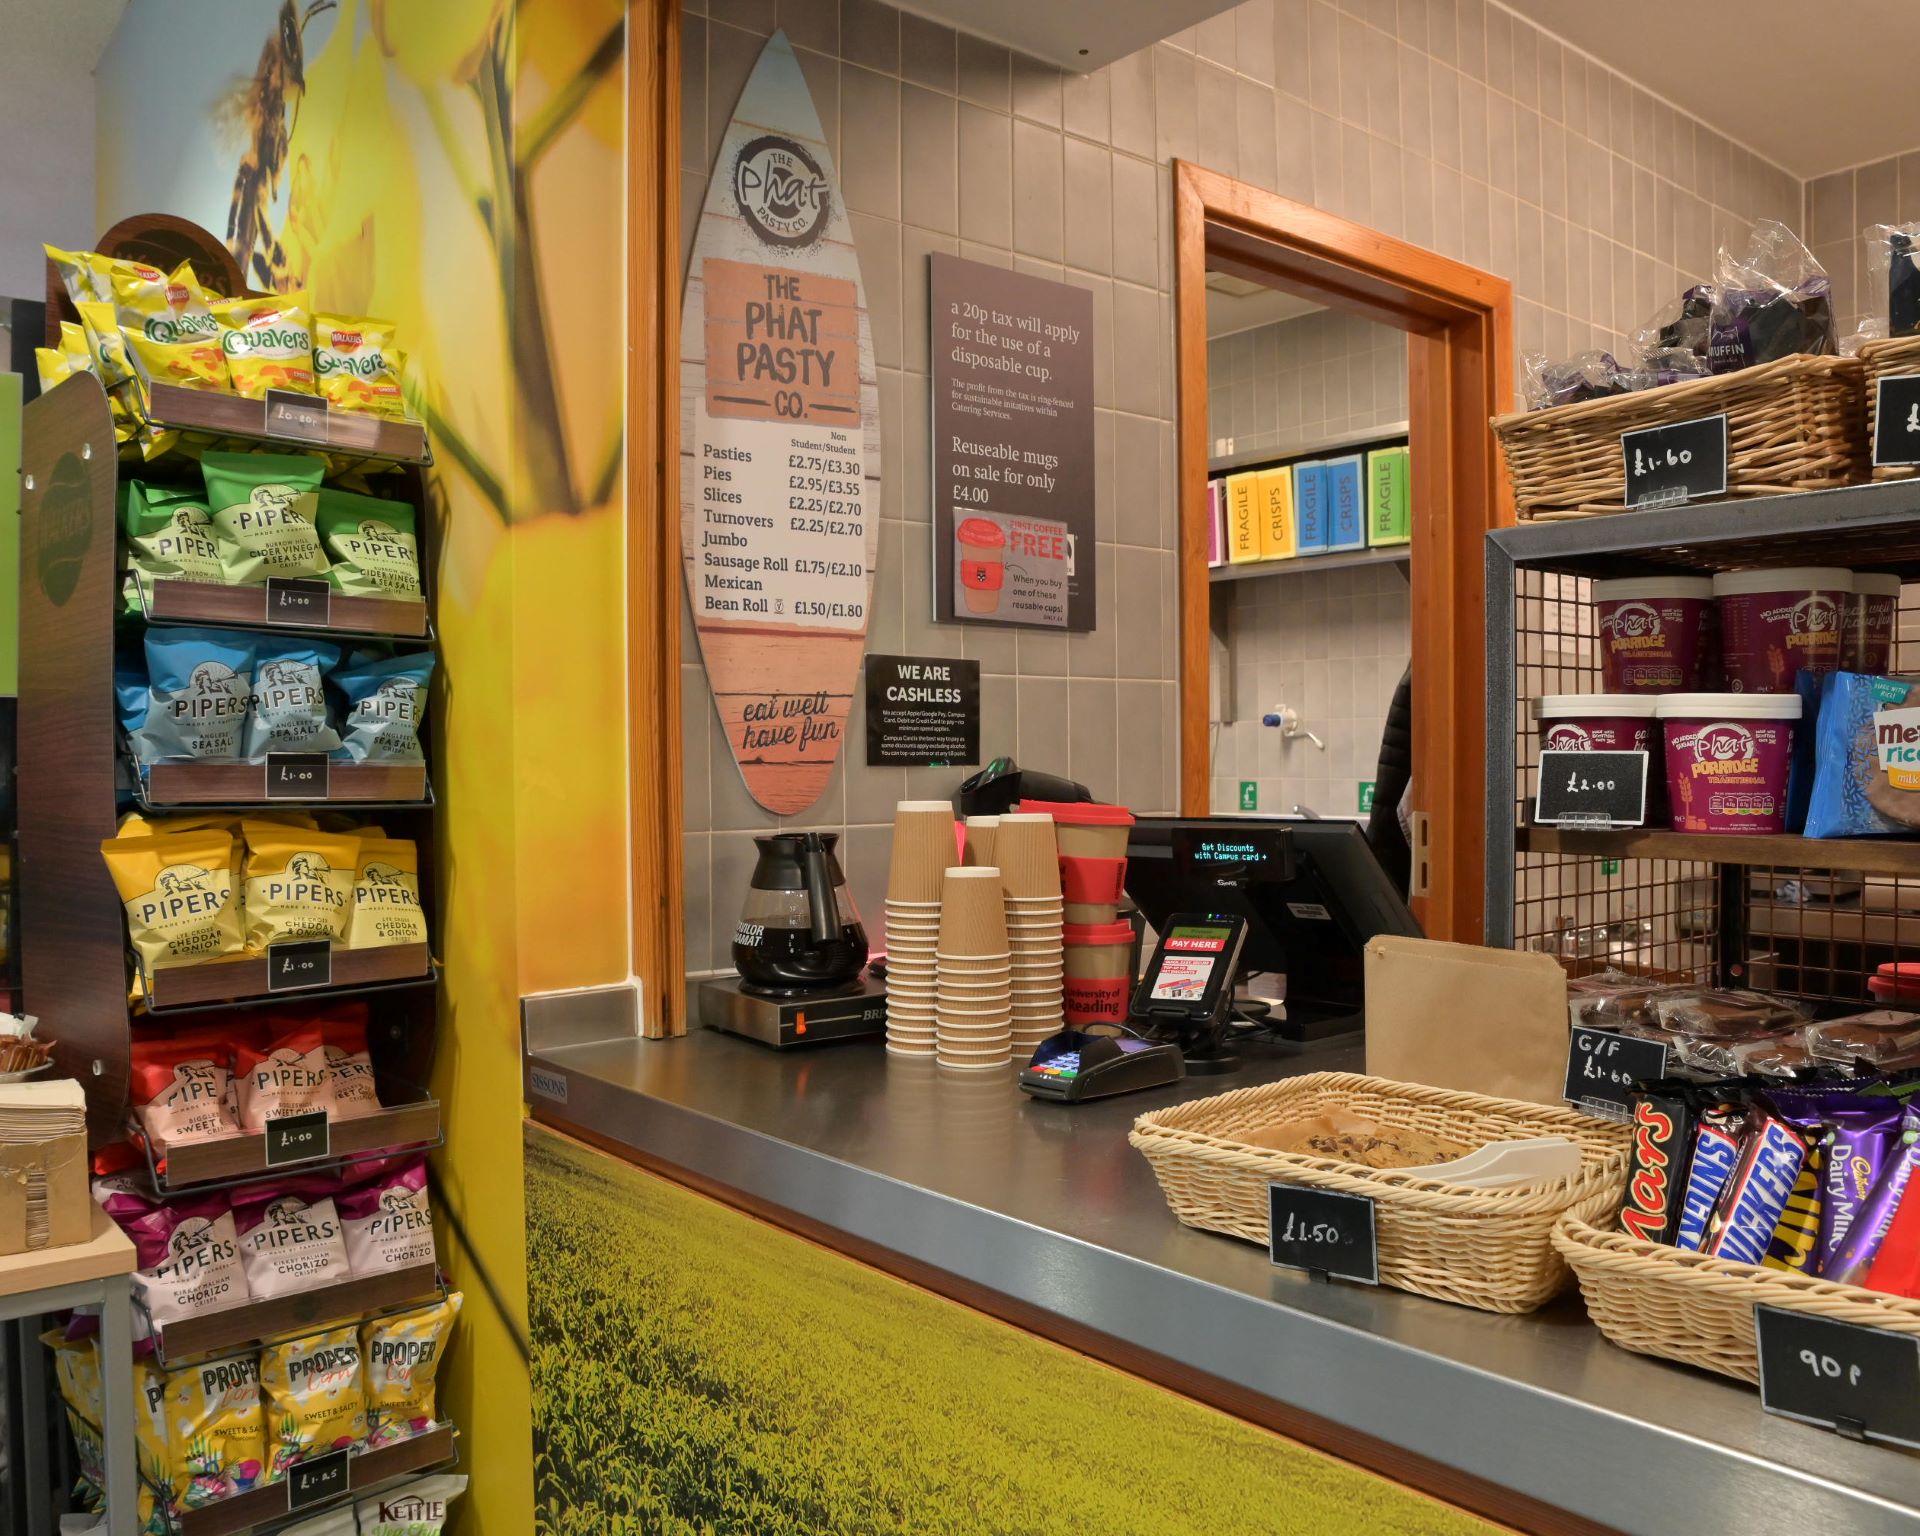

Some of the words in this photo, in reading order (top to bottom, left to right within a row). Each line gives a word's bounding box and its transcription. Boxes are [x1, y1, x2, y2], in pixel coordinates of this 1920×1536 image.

[771, 153, 793, 167] THE
[738, 160, 827, 210] Phat
[757, 206, 790, 232] PASTY
[793, 221, 808, 231] CO.
[764, 274, 800, 301] THE
[746, 302, 822, 345] PHAT
[951, 302, 959, 314] a
[963, 302, 988, 324] 20p
[992, 310, 1012, 327] tax
[1017, 316, 1041, 333] will
[1045, 323, 1080, 344] apply
[222, 329, 309, 355] Quavers
[331, 333, 363, 347] WALKERS
[952, 323, 972, 340] for
[976, 329, 997, 345] the
[1002, 336, 1023, 351] use
[1028, 341, 1042, 354] of
[1044, 345, 1051, 357] a
[1709, 343, 1744, 357] MUFFIN
[737, 342, 835, 386] PASTY
[952, 347, 1022, 373] disposable
[1026, 365, 1052, 382] cup.
[952, 378, 965, 388] The
[774, 390, 808, 418] CO.
[952, 402, 982, 416] Catering
[831, 432, 846, 441] Non
[791, 439, 856, 455] Student/Student
[952, 436, 1020, 461] Reuseable
[1023, 451, 1059, 470] mugs
[704, 444, 752, 462] Pasties
[789, 455, 860, 475] £2.75/£3.30
[1634, 448, 1692, 477] £1.60
[704, 465, 732, 481] Pies
[789, 476, 860, 496] £2.95/£3.55
[952, 464, 971, 477] on
[974, 465, 1000, 481] sale
[1004, 468, 1023, 485] for
[1027, 474, 1056, 493] only
[704, 488, 742, 504] Slices
[789, 497, 861, 516] £2.25/£2.70
[953, 485, 989, 503] £4.00
[1340, 475, 1353, 531] CRISPS
[1380, 462, 1391, 532] FRAGILE
[1270, 487, 1284, 541] CRISPS
[1305, 473, 1317, 540] FRAGILE
[704, 509, 774, 528] Turnovers
[791, 518, 863, 536] £2.25/£2.70
[1237, 486, 1250, 550] FRAGILE
[702, 531, 748, 547] Jumbo
[1034, 523, 1063, 535] COFFEE
[250, 549, 280, 558] CIDER
[1010, 531, 1064, 560] FREE
[271, 555, 289, 563] SEA
[291, 551, 315, 560] SALT
[704, 553, 759, 571] Sausage
[764, 557, 788, 571] Roll
[795, 560, 861, 577] £1.75/£2.10
[360, 569, 387, 578] CIDER
[705, 574, 763, 591] Mexican
[1013, 574, 1034, 584] When
[1035, 578, 1048, 586] you
[1050, 580, 1062, 588] buy
[379, 578, 395, 586] SEA
[396, 581, 415, 591] SALT
[1027, 589, 1036, 597] of
[1037, 591, 1056, 599] these
[279, 591, 310, 606] £1.00
[705, 596, 739, 611] Bean
[743, 599, 768, 612] Roll
[795, 602, 863, 618] £1.50/£1.80
[1012, 602, 1043, 610] reusable
[1045, 604, 1063, 614] cups!
[898, 665, 920, 679] WE
[923, 666, 950, 680] ARE
[250, 689, 326, 711] PIPERS
[887, 686, 961, 703] CASHLESS
[174, 696, 247, 718] PIPERS
[743, 695, 779, 721] eat
[783, 691, 829, 716] well
[270, 728, 292, 738] SEA
[294, 725, 320, 736] SALT
[743, 725, 797, 749] have
[799, 716, 839, 751] fun
[192, 740, 212, 750] SEA
[374, 736, 392, 744] SEA
[393, 738, 416, 750] SALT
[1672, 738, 1680, 746] NO
[280, 766, 312, 781] £1.00
[1691, 758, 1759, 778] PORRIDGE
[1567, 771, 1615, 792] £2.00
[1195, 852, 1212, 860] with
[1214, 852, 1238, 861] Campus
[1241, 853, 1259, 861] card
[1217, 844, 1254, 852] Discounts
[269, 883, 344, 907] PIPERS
[356, 888, 420, 906] PIPERS
[142, 889, 231, 923] PIPERS
[285, 920, 334, 933] CHEDDAR
[295, 927, 331, 937] ONION
[375, 922, 417, 930] CHEDDAR
[387, 929, 418, 937] ONION
[168, 930, 222, 949] CHEDDAR
[181, 939, 221, 953] ONION
[282, 958, 314, 973] £1.00
[1112, 989, 1120, 998] of
[1578, 1034, 1620, 1056] G/F
[257, 1069, 325, 1089] PIPERS
[1584, 1055, 1632, 1085] £1.60
[265, 1107, 294, 1118] SWEET
[176, 1118, 216, 1135] SWEET
[281, 1131, 313, 1147] £1.00
[1826, 1145, 1852, 1199] Dairy
[370, 1209, 432, 1235] PIPERS
[1282, 1212, 1339, 1243] £1.50
[1829, 1202, 1855, 1252] Milk
[253, 1221, 334, 1250] PIPERS
[157, 1239, 235, 1279] PIPERS
[385, 1247, 431, 1263] CHORIZO
[278, 1258, 329, 1275] CHORIZO
[177, 1283, 230, 1305] CHORIZO
[371, 1341, 436, 1364] PROPER
[304, 1409, 331, 1421] SWEET
[340, 1402, 358, 1414] SALTY
[214, 1428, 241, 1436] SWEET
[379, 1495, 443, 1523] KETTLE
